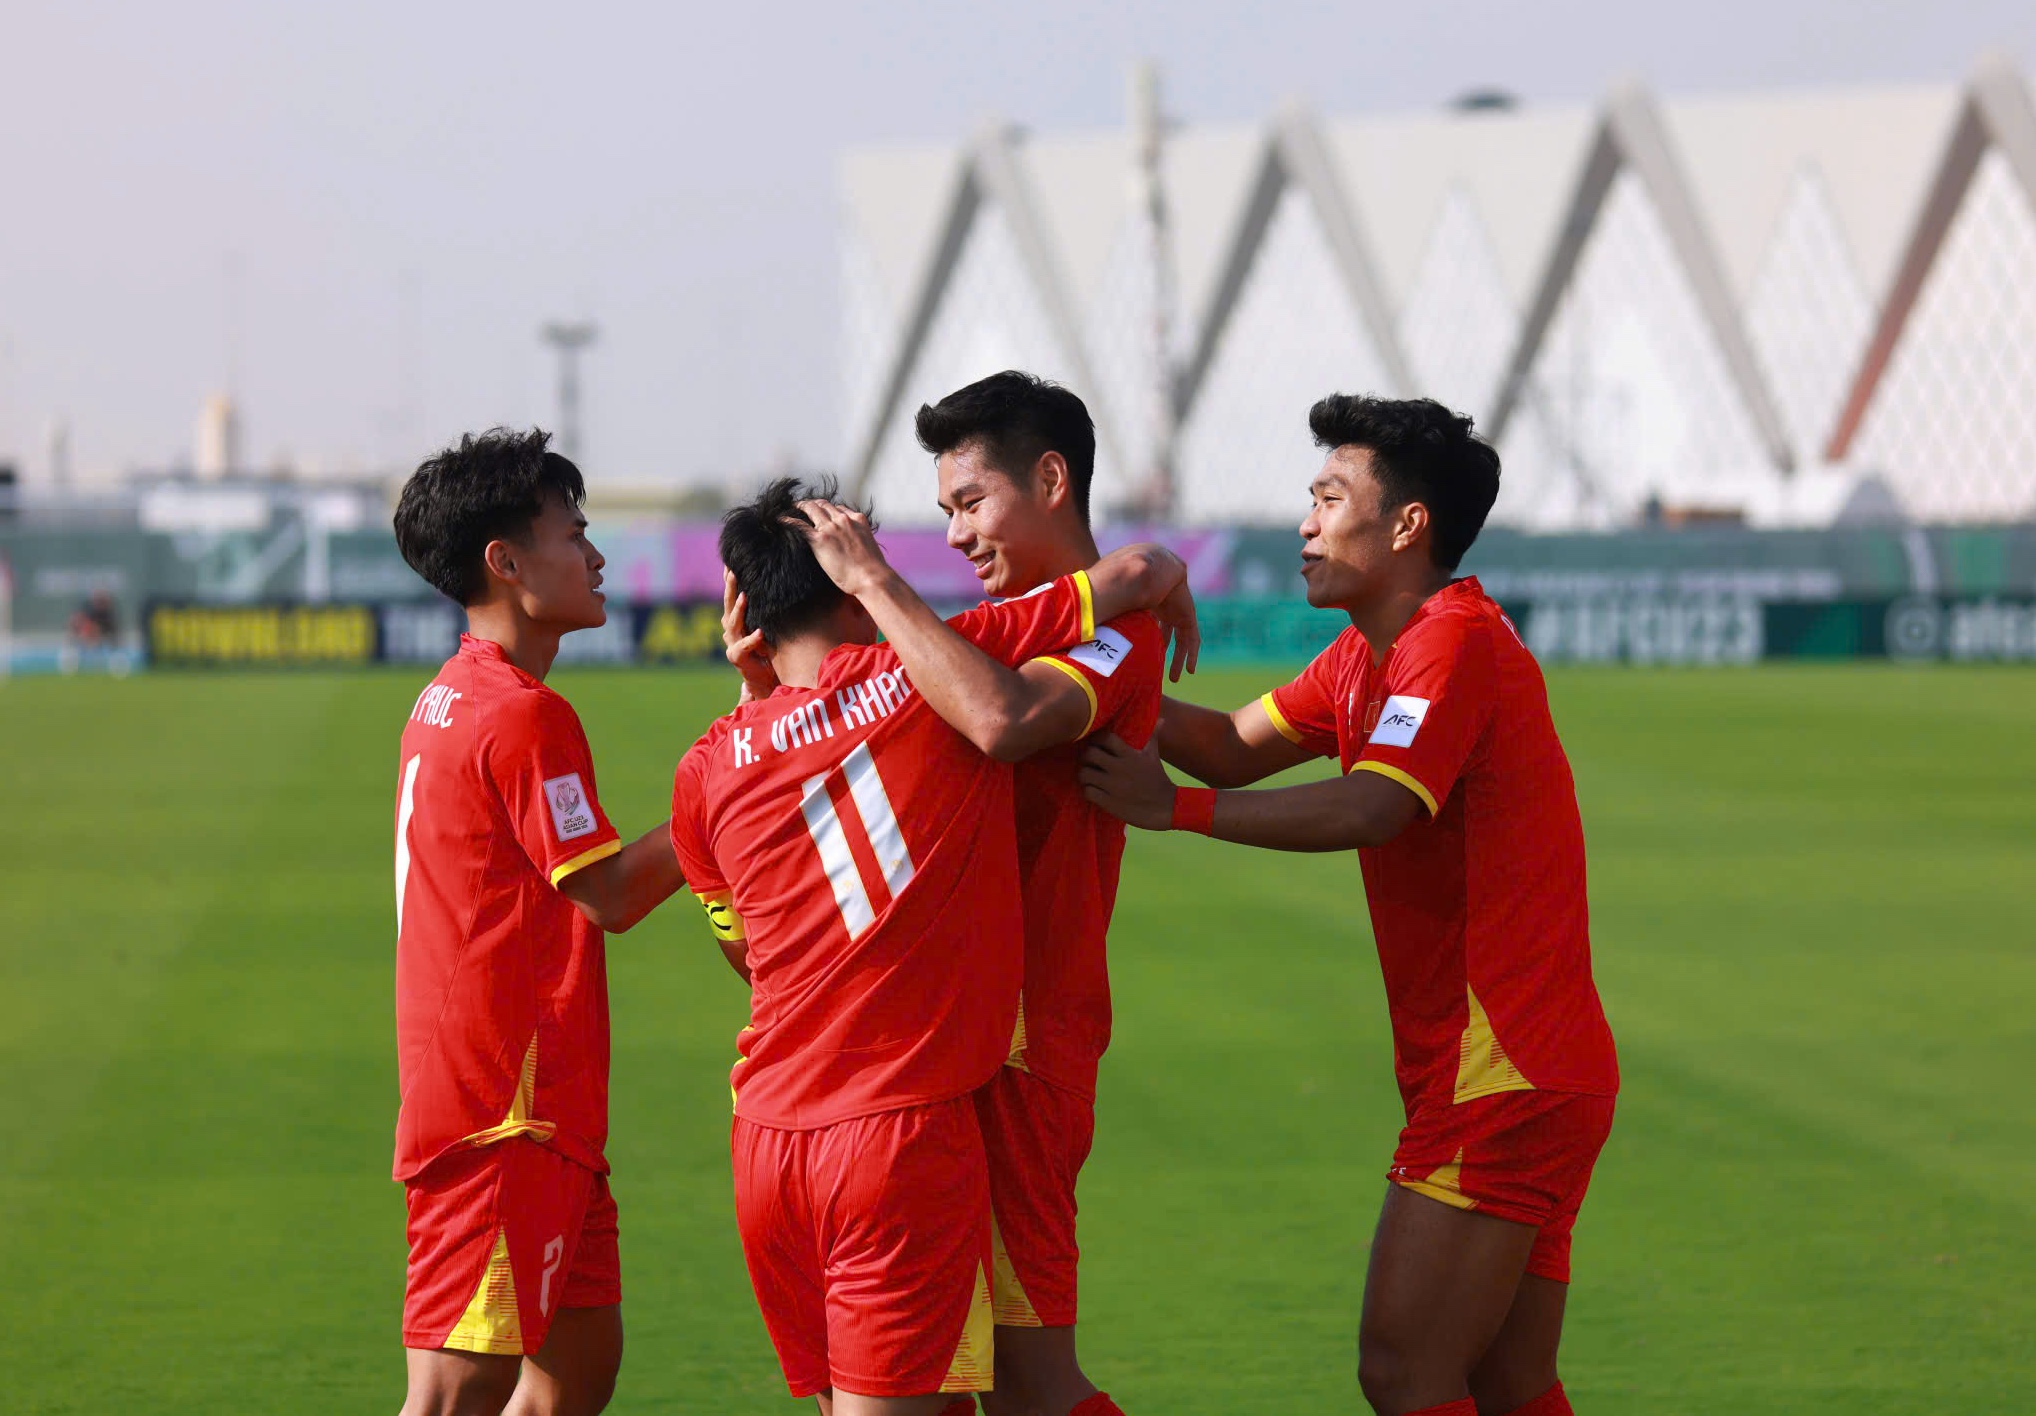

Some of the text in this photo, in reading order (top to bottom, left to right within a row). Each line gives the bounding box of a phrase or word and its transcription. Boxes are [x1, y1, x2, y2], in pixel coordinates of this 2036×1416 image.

[1382, 714, 1416, 727] AFC
[733, 727, 761, 769] K.
[771, 698, 834, 753] VAN
[564, 817, 575, 825] AFC
[577, 818, 589, 826] CUP
[799, 739, 916, 942] 11
